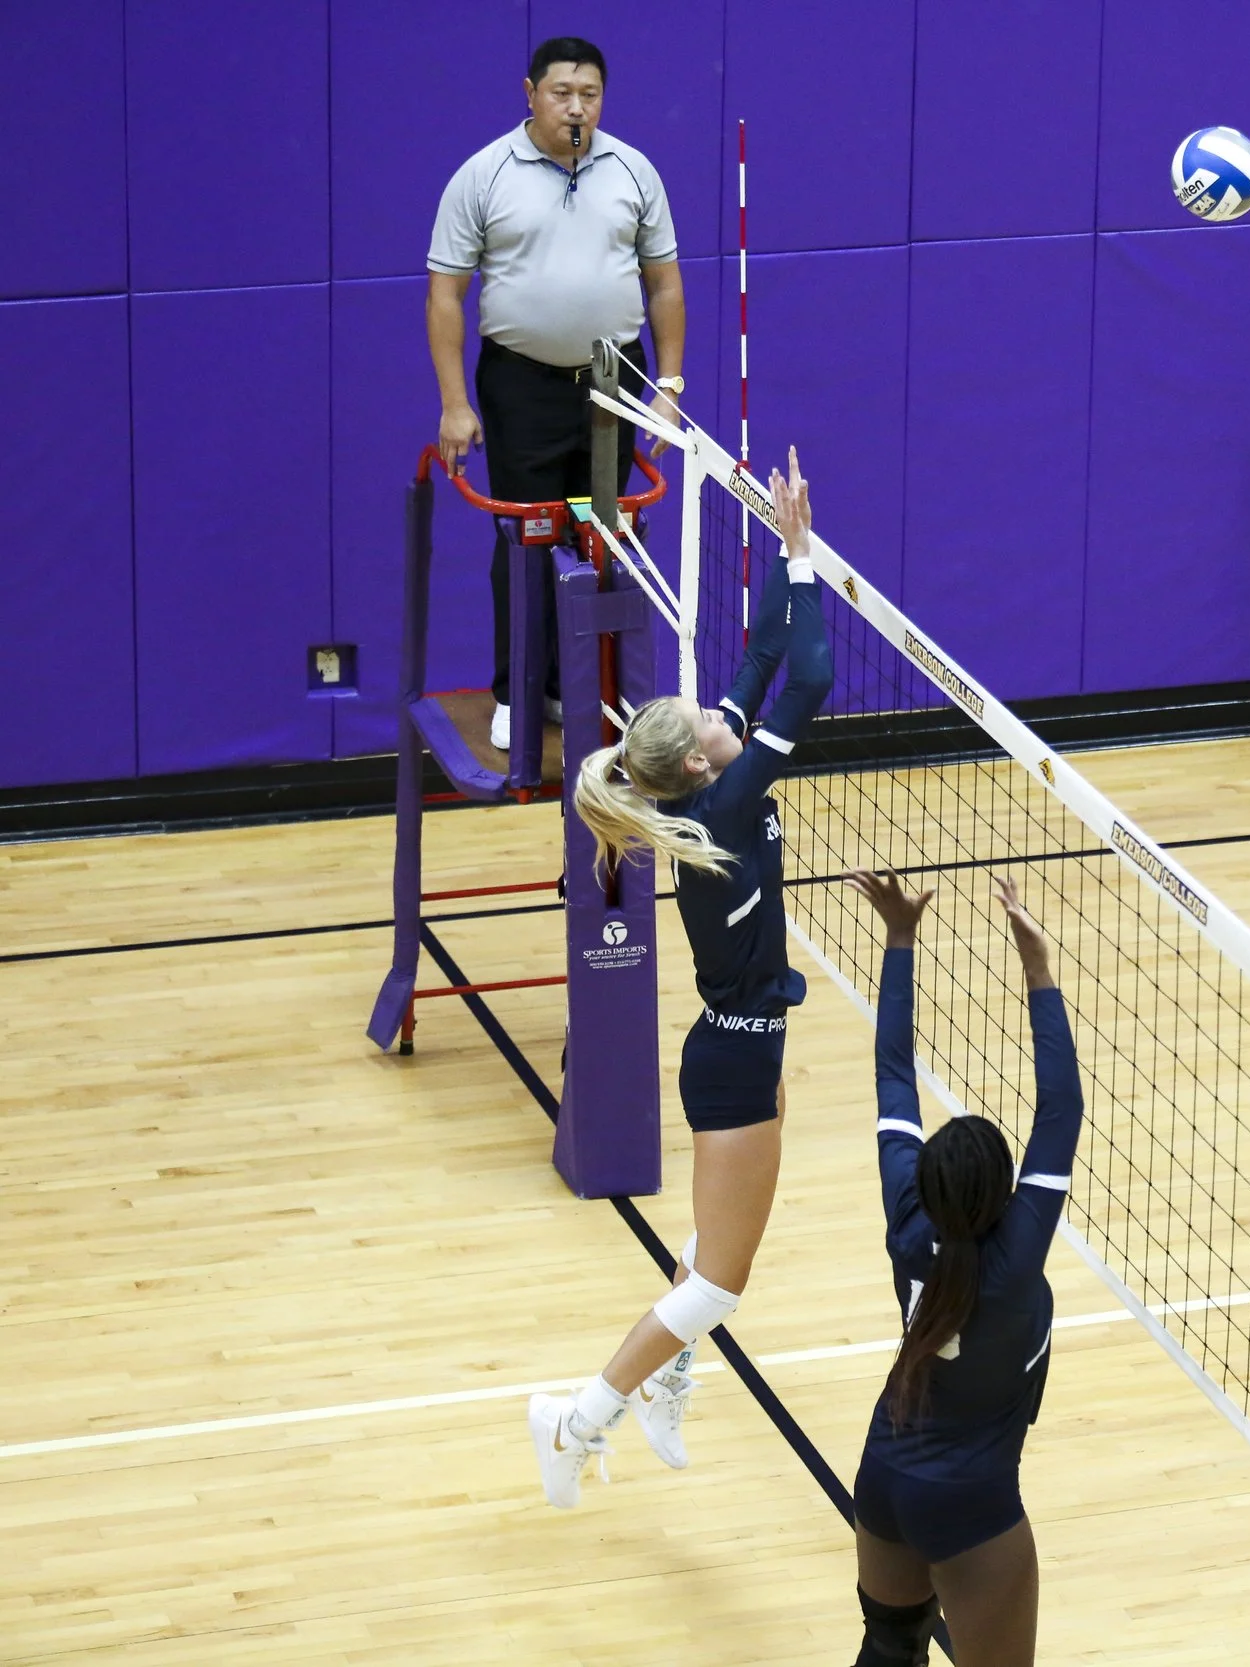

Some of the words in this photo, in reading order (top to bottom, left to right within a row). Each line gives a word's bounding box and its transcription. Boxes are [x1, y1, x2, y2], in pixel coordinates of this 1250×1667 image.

[729, 470, 766, 518] EMERSON
[905, 630, 946, 685] EMERSON
[945, 667, 985, 720] COLLEGE
[1111, 820, 1163, 884] EMERSON
[1161, 866, 1209, 927] COLLEGE
[583, 948, 612, 959] SPORTS
[612, 945, 648, 955] IMPORTS
[716, 1013, 767, 1032] NIKE
